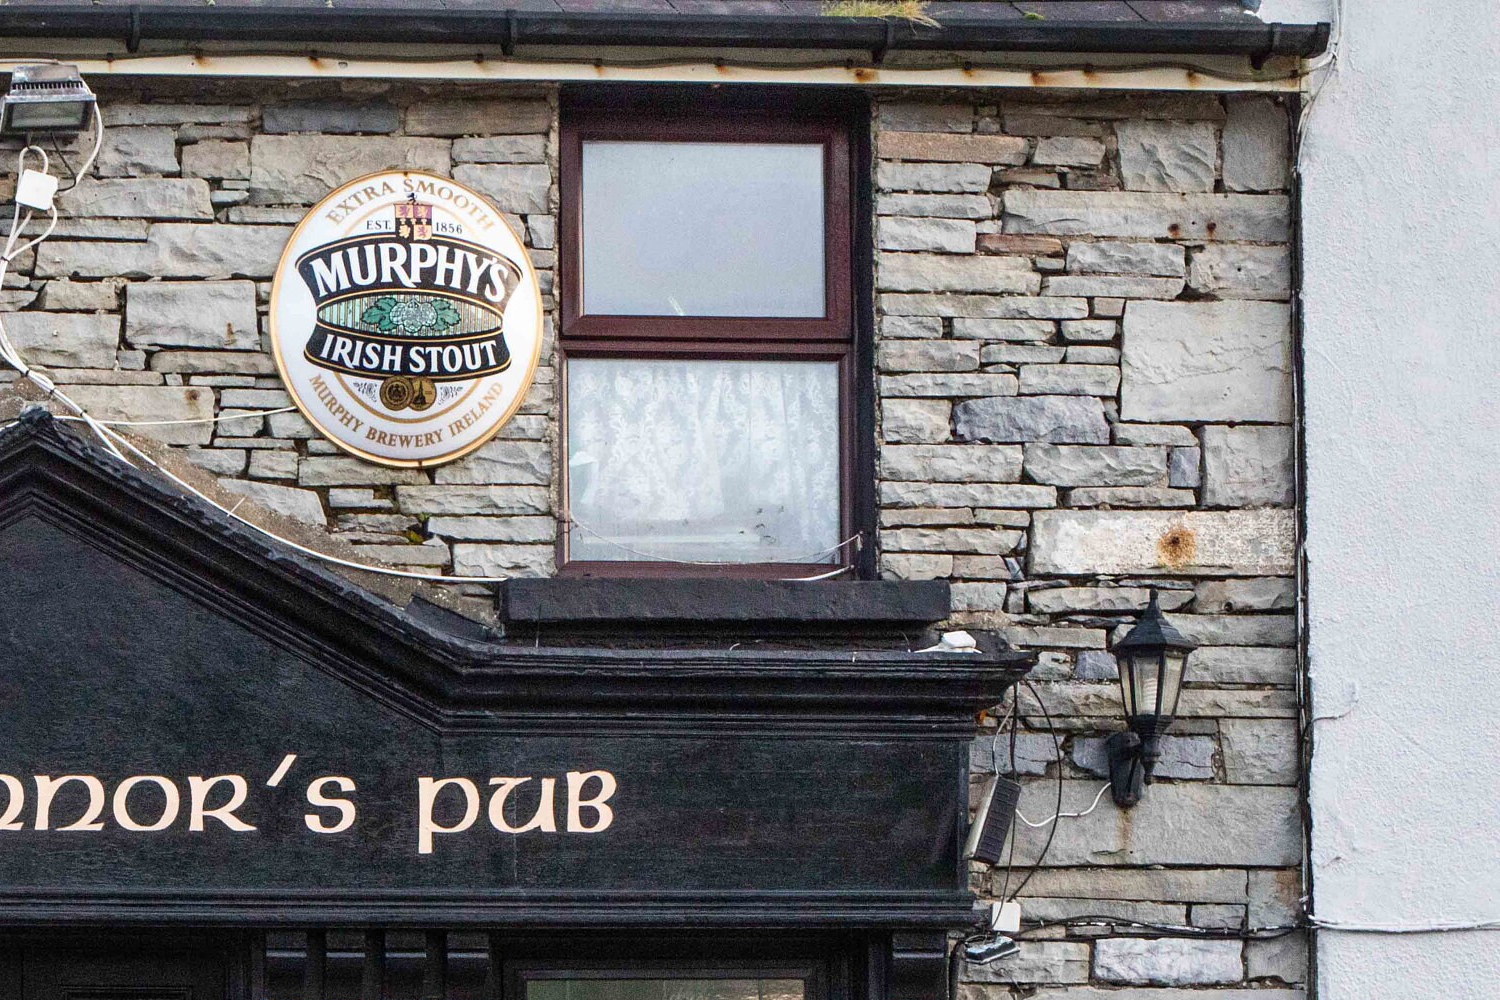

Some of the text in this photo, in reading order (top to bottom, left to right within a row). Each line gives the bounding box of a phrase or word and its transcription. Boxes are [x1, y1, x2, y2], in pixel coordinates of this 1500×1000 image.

[326, 178, 496, 231] EXTRA SMOOTH
[366, 219, 463, 235] EST. 1856
[309, 242, 509, 302] MURPHY'S
[319, 333, 498, 374] IRISH STOUT
[308, 374, 504, 449] MURPHY BREWERY IRELAND
